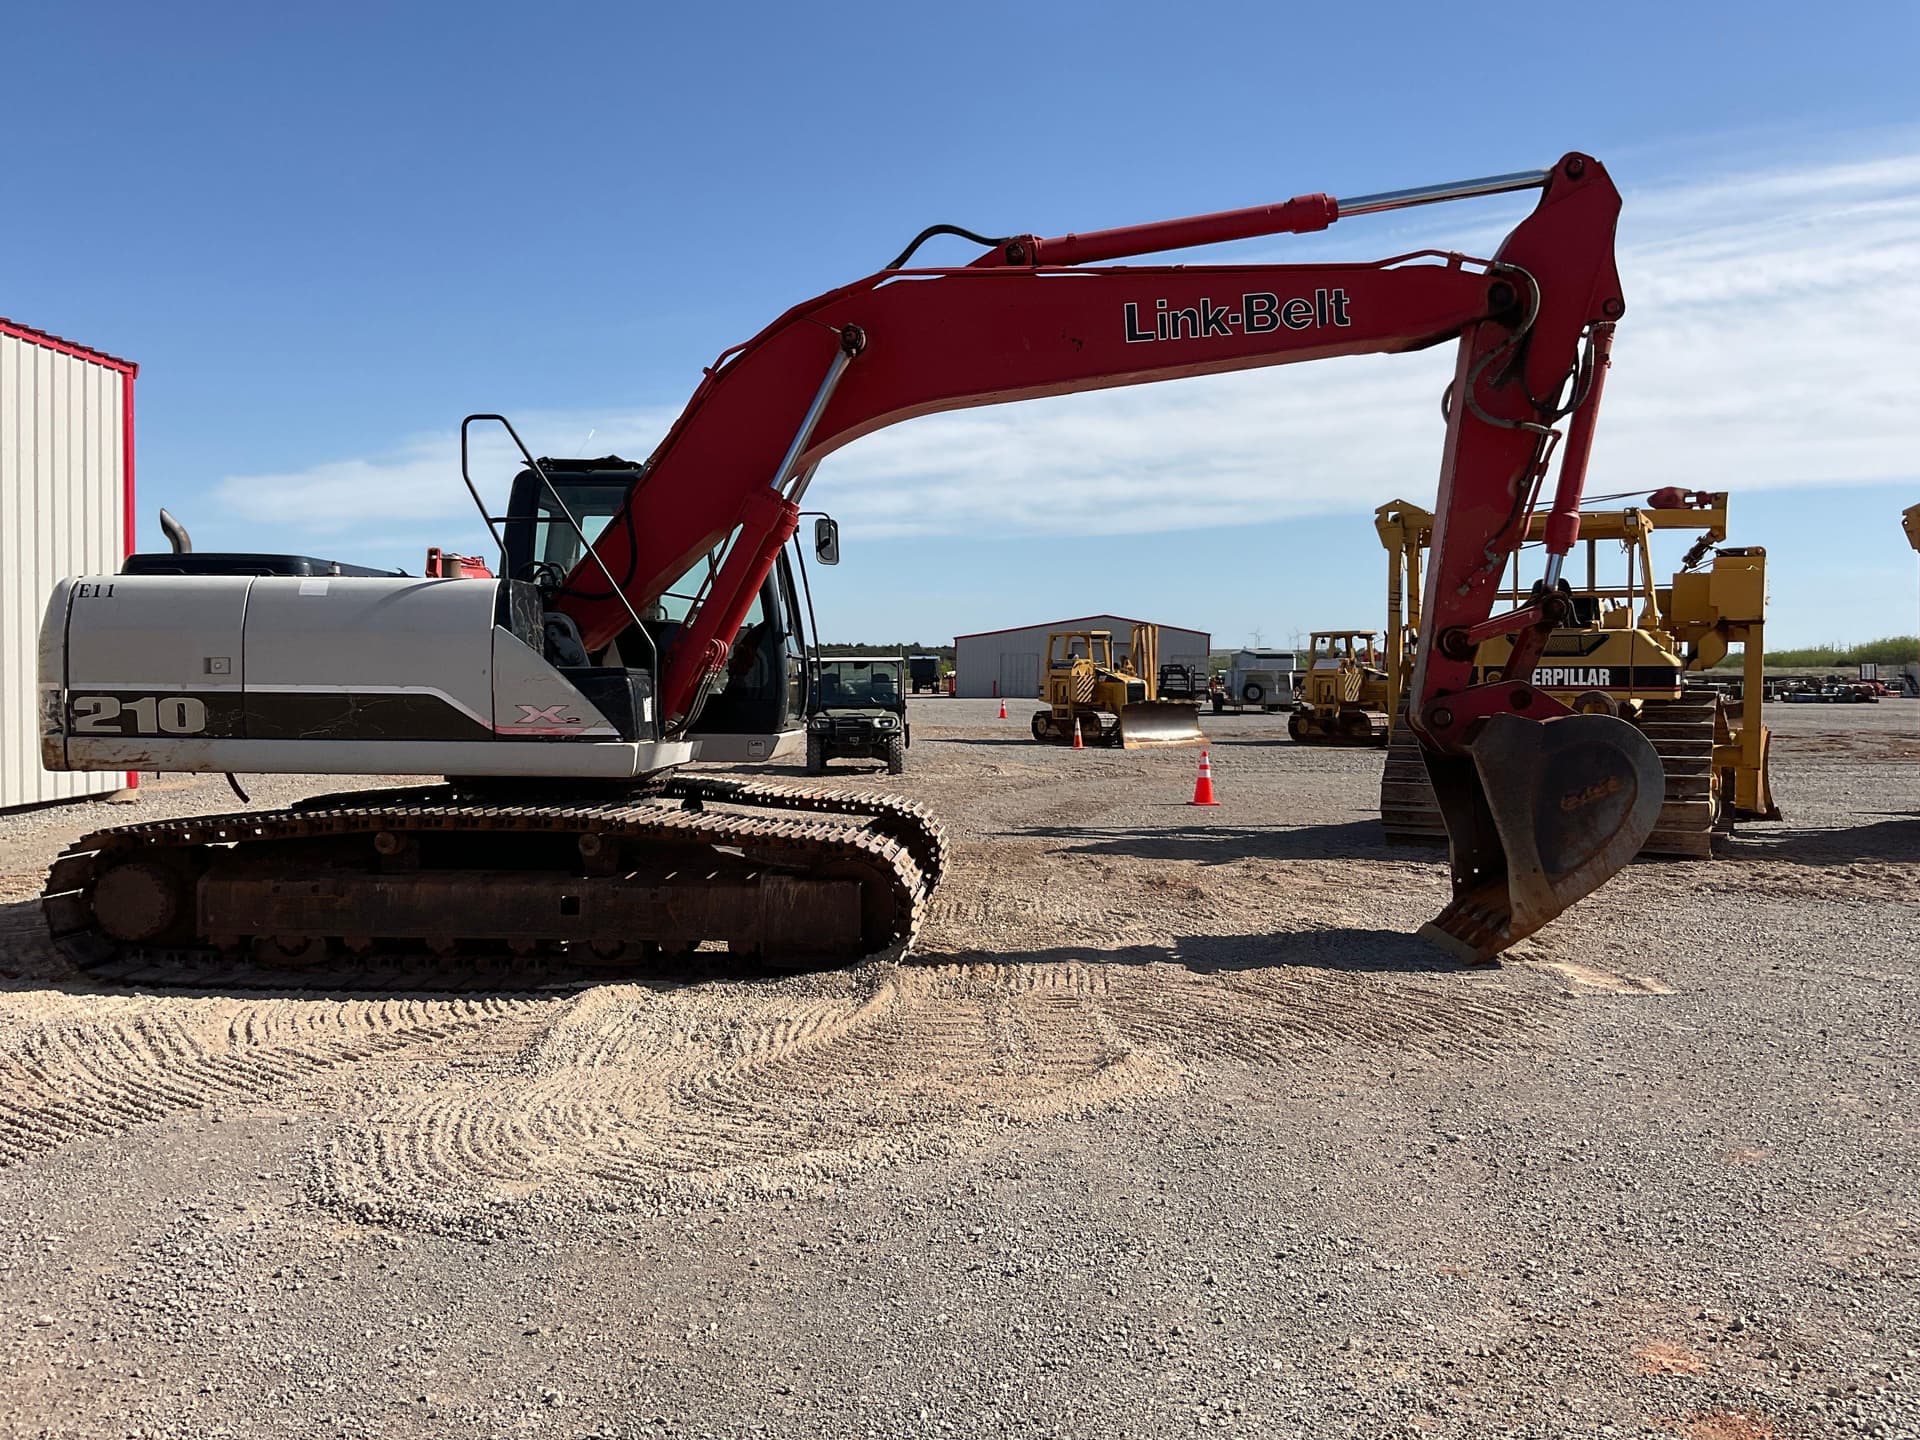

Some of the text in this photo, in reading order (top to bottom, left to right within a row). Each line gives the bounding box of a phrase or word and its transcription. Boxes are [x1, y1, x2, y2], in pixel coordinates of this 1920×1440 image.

[1124, 288, 1351, 343] Link-Belt
[78, 583, 114, 598] E11
[1532, 668, 1610, 686] ERPILLAR
[74, 696, 206, 734] 210
